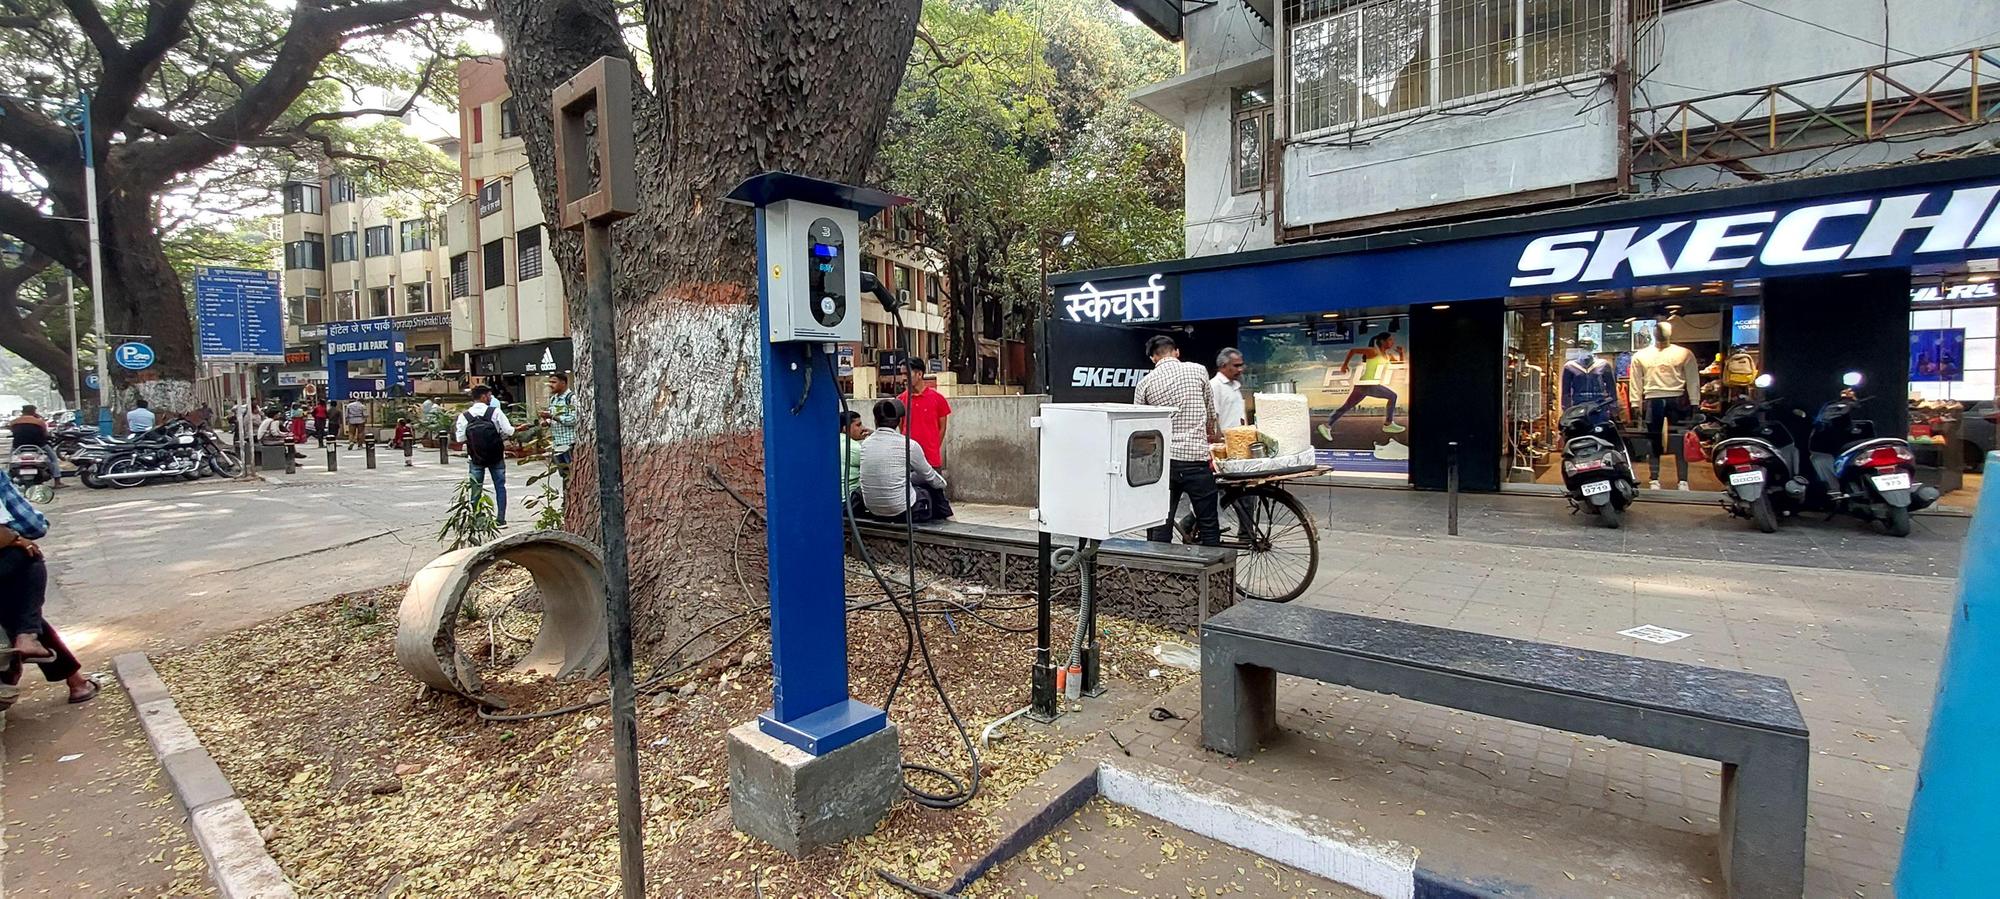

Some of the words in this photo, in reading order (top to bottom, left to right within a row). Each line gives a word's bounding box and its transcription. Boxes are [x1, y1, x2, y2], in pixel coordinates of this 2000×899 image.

[1508, 186, 2000, 288] SKECH
[1063, 273, 1166, 322] स्केचर्स
[351, 323, 359, 333] जे
[361, 323, 371, 333] एम
[374, 319, 390, 331] पार्क
[336, 343, 357, 353] HOTEL
[358, 342, 362, 351] J
[370, 340, 388, 350] PARK
[1584, 484, 1608, 494] 9719
